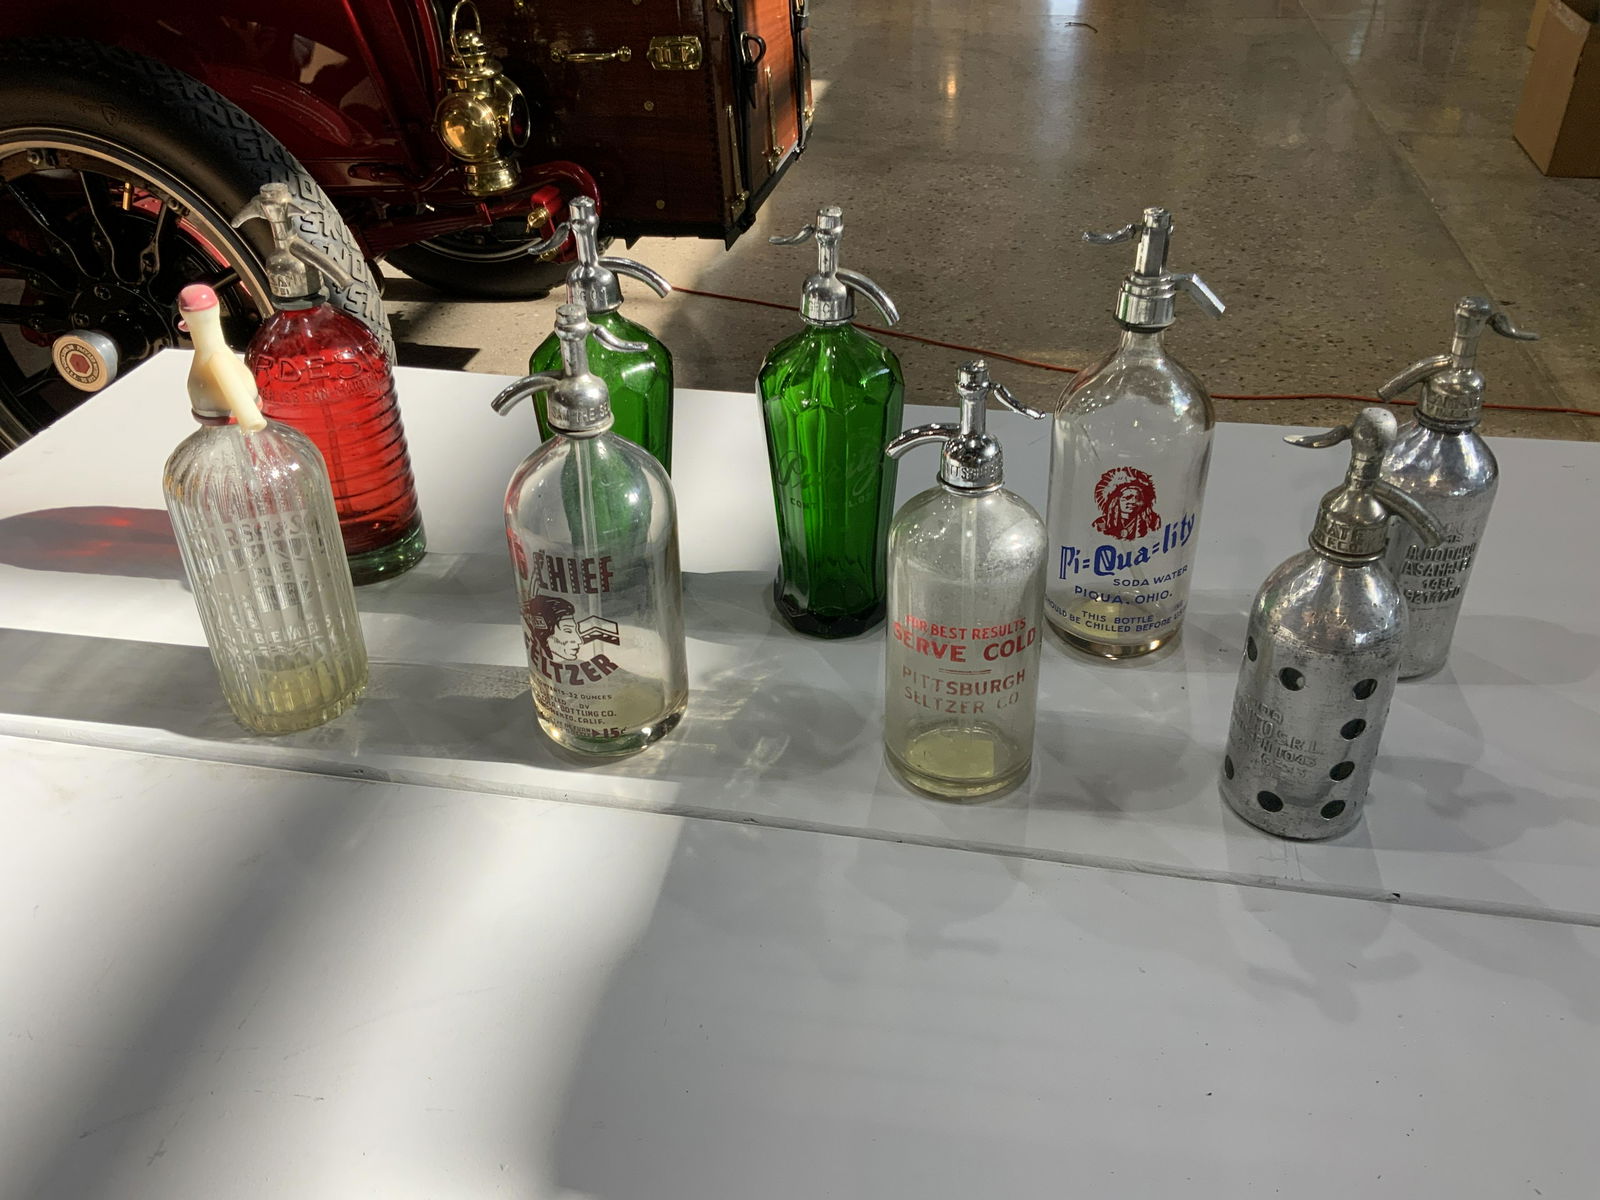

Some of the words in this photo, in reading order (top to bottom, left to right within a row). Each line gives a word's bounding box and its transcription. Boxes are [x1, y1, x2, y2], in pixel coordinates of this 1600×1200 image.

[532, 550, 614, 594] CHIEF
[1113, 578, 1149, 587] SODA
[1153, 565, 1188, 585] WATER
[1135, 590, 1173, 605] OHIO.
[905, 615, 928, 633] FOR
[931, 623, 968, 641] BEST
[971, 617, 1027, 641] RESULTS
[1069, 613, 1081, 624] BE
[1085, 620, 1131, 633] CHILLED
[1136, 617, 1172, 632] BEFORE
[1082, 610, 1106, 622] THIS
[1114, 615, 1154, 624] BOTTLE
[893, 621, 967, 663] SERVE
[983, 627, 1036, 662] COLD
[902, 665, 1026, 697] PITTSBURGH
[904, 686, 985, 714] SELTZER
[560, 706, 600, 718] BOTTLING
[601, 710, 617, 718] CO.
[578, 717, 606, 726] CALIF.
